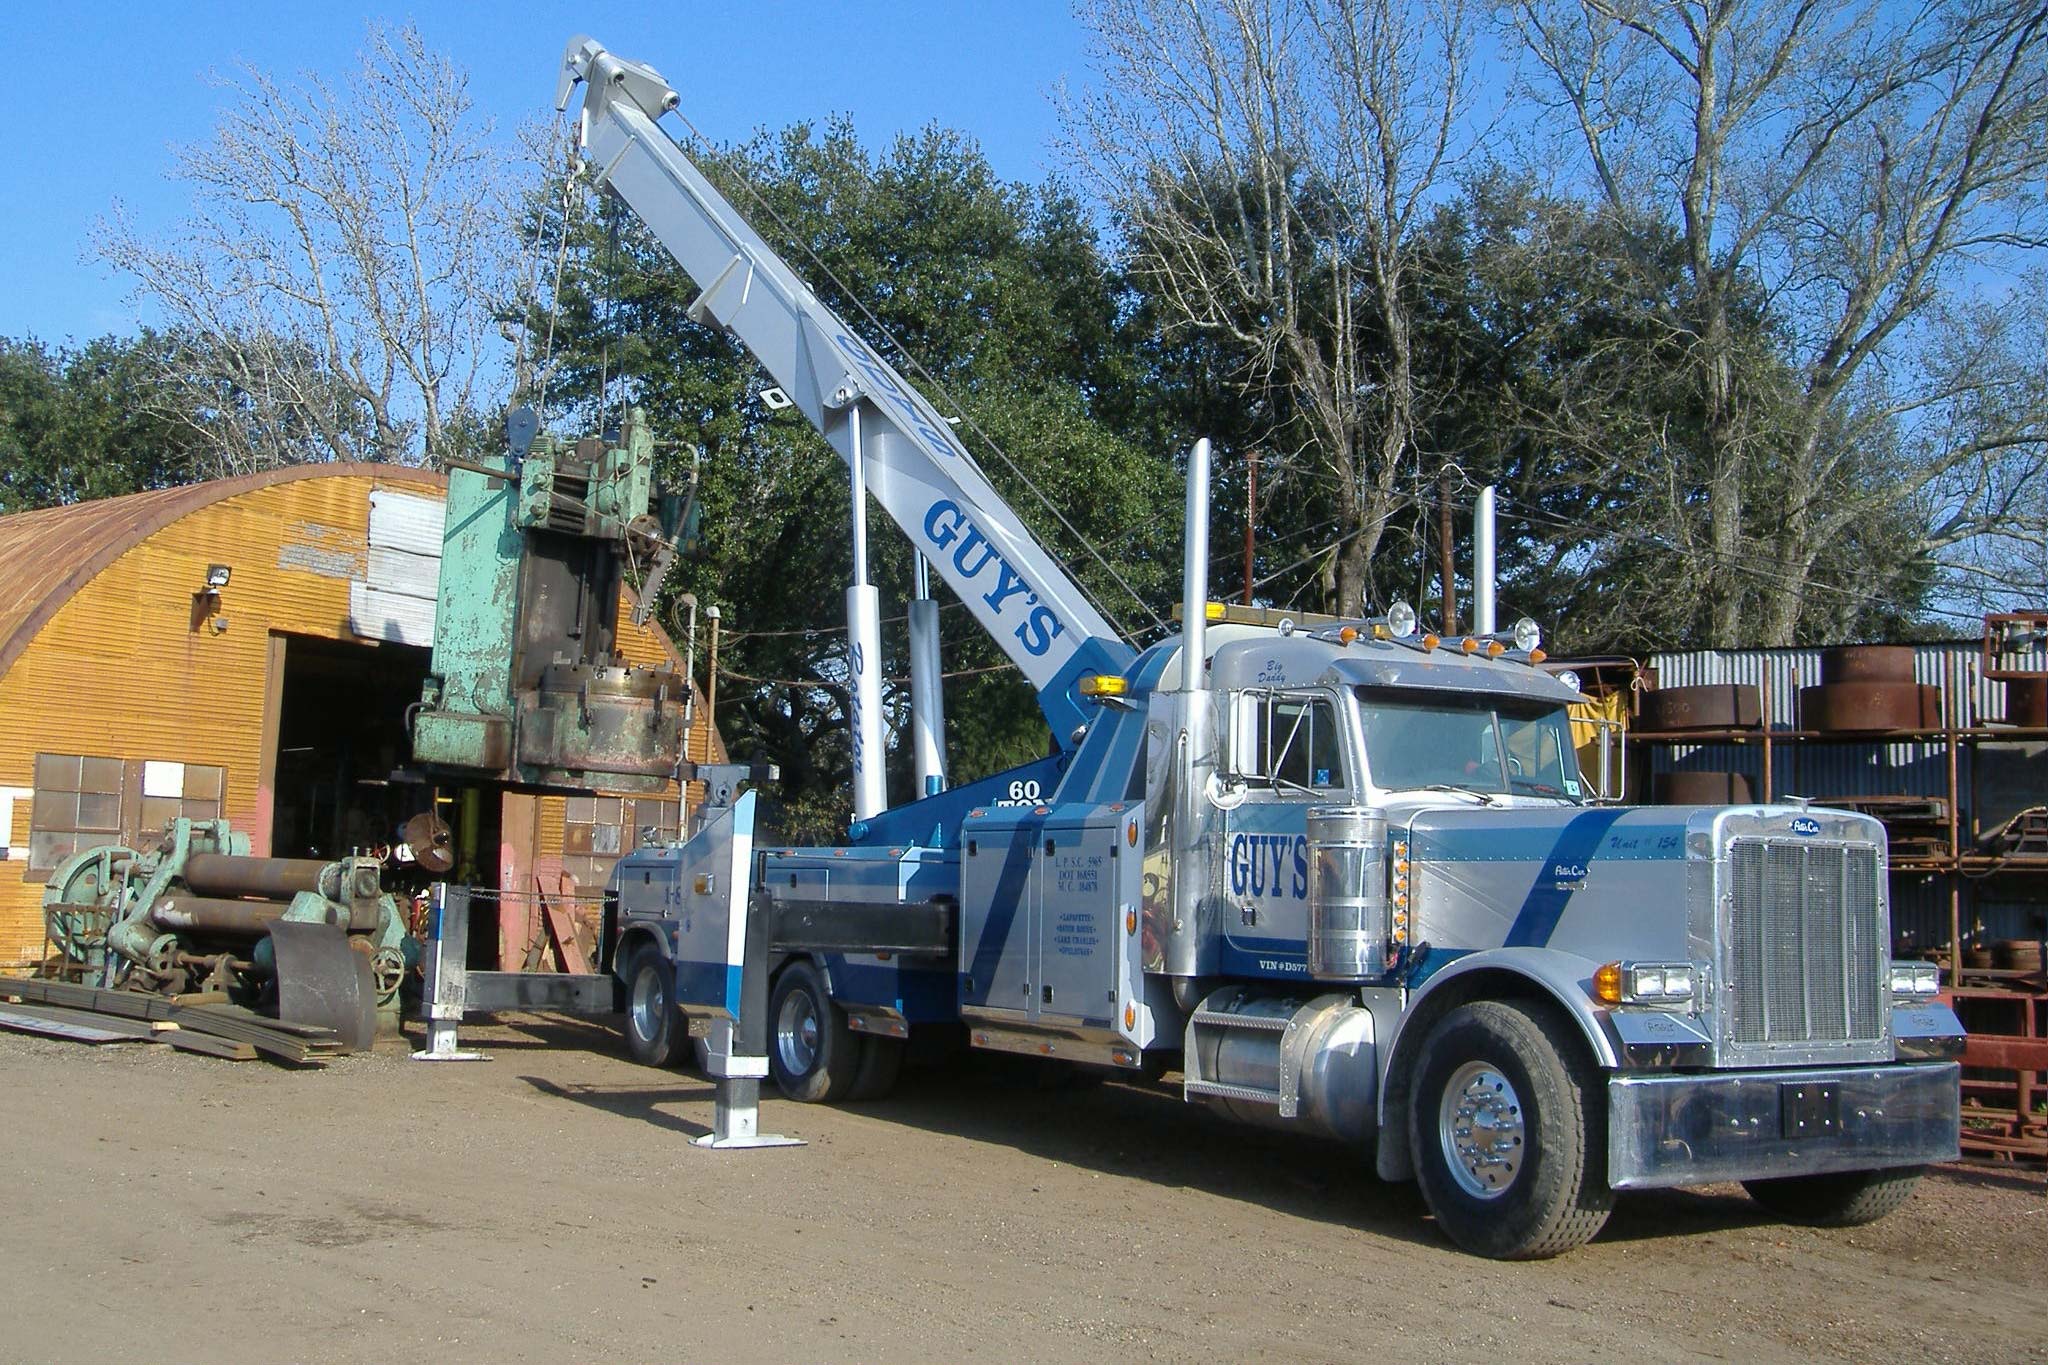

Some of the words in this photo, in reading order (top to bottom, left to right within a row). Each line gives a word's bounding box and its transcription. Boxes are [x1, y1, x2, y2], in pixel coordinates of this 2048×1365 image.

[924, 499, 1065, 657] GUY'S
[1266, 660, 1282, 673] Big
[1258, 672, 1286, 683] Daddy
[850, 641, 864, 773] Rotator
[1009, 780, 1040, 800] 60
[1610, 836, 1638, 849] Unit
[1231, 834, 1308, 900] GUY'S
